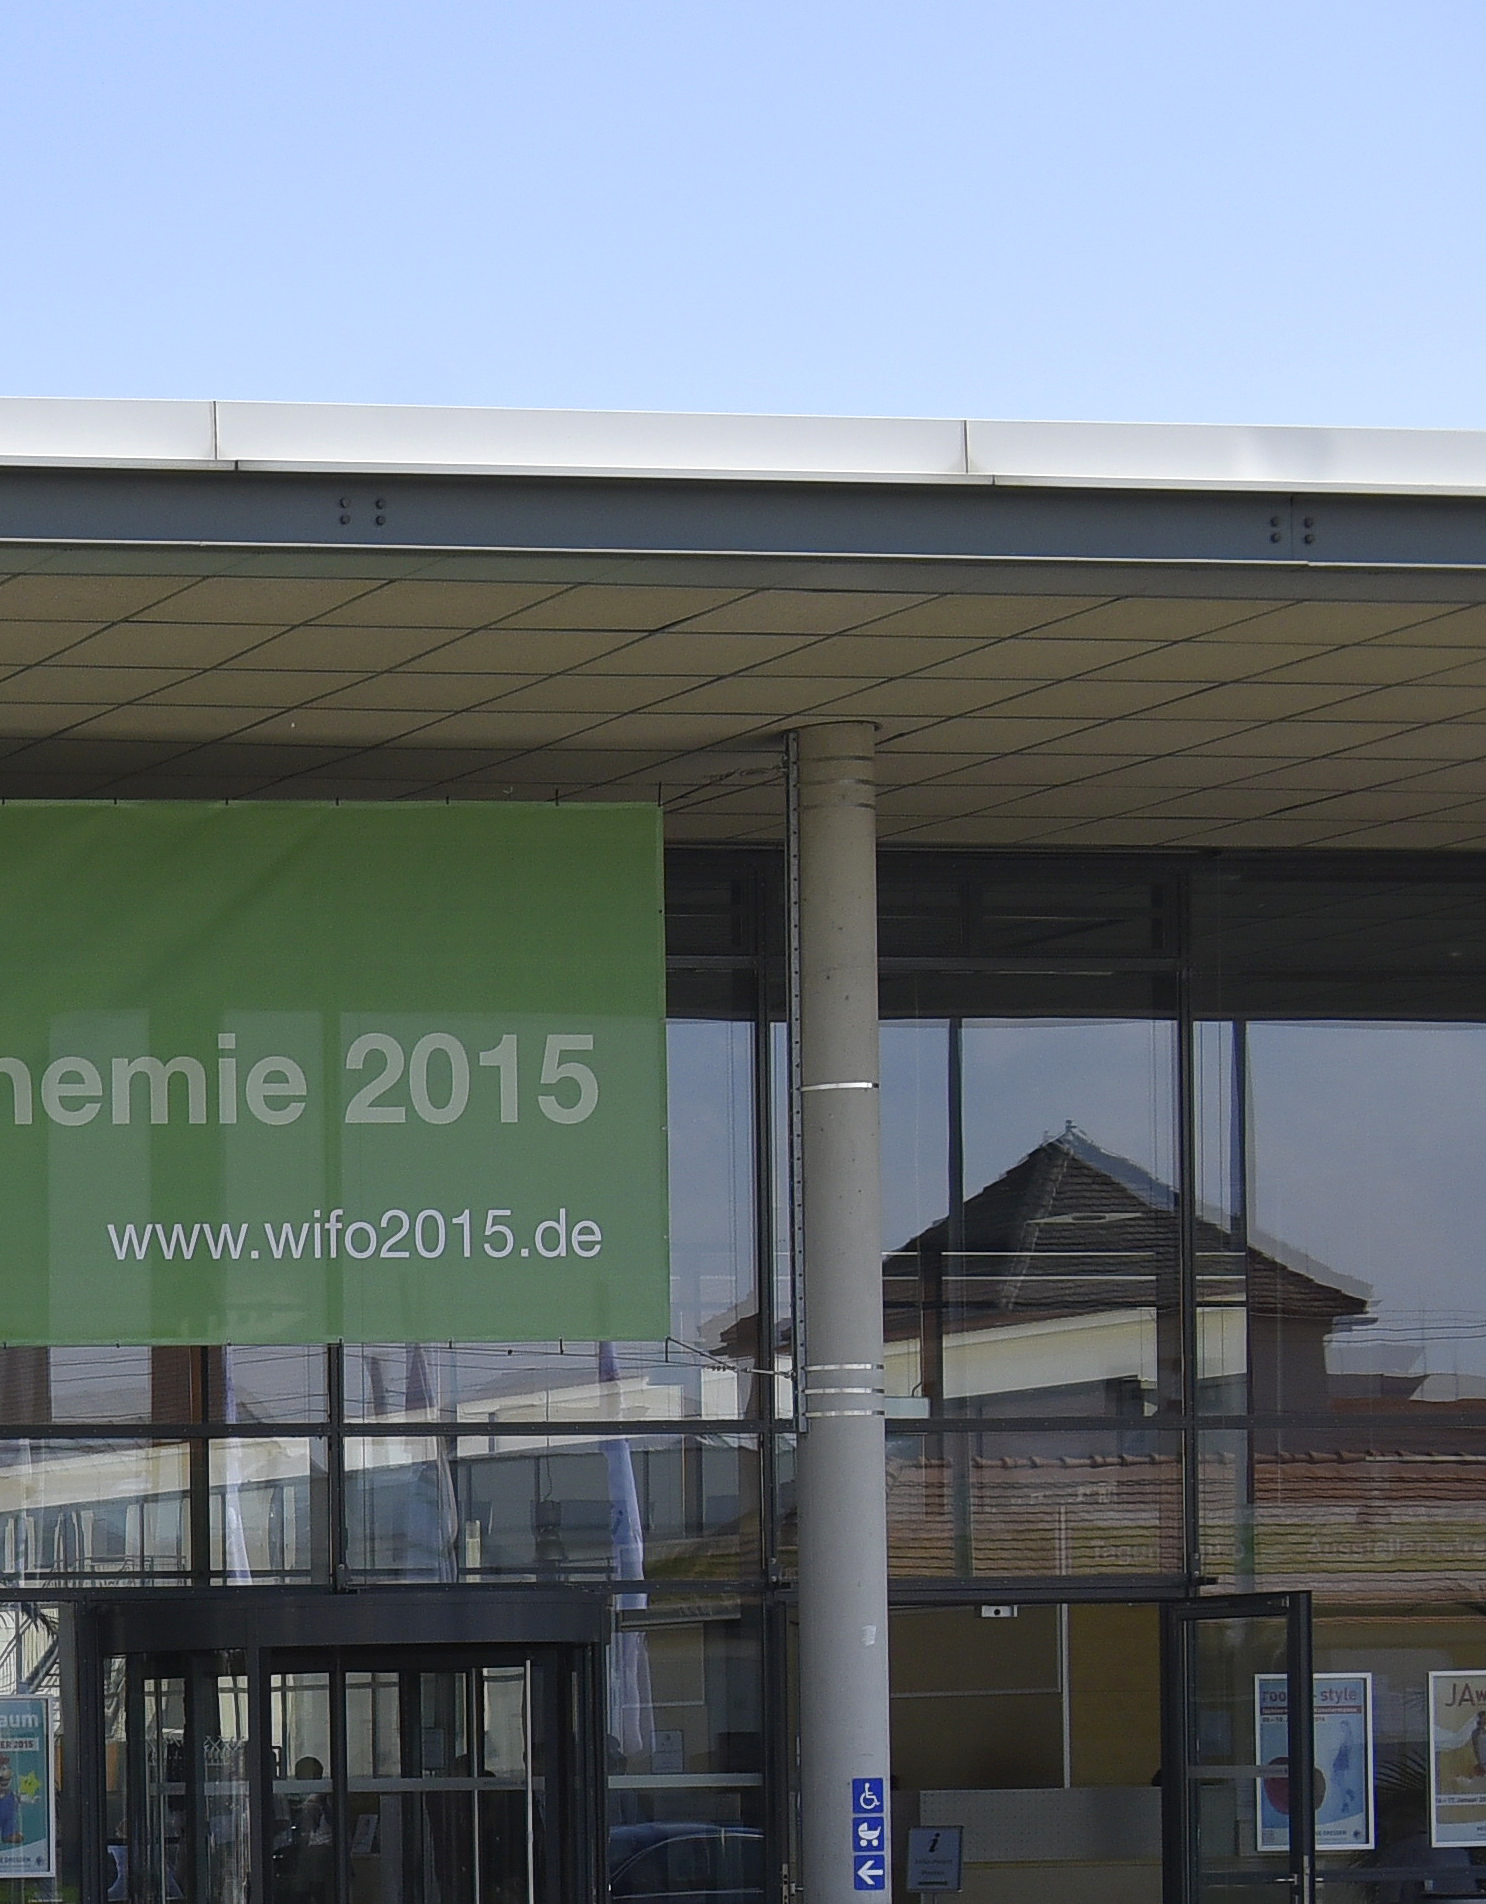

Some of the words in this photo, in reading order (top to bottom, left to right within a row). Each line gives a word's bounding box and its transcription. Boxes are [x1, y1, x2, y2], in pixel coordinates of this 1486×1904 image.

[345, 1033, 598, 1124] 2015
[107, 1208, 603, 1261] www.wifo2015.de
[1320, 1687, 1357, 1704] style
[13, 1739, 34, 1749] 2015
